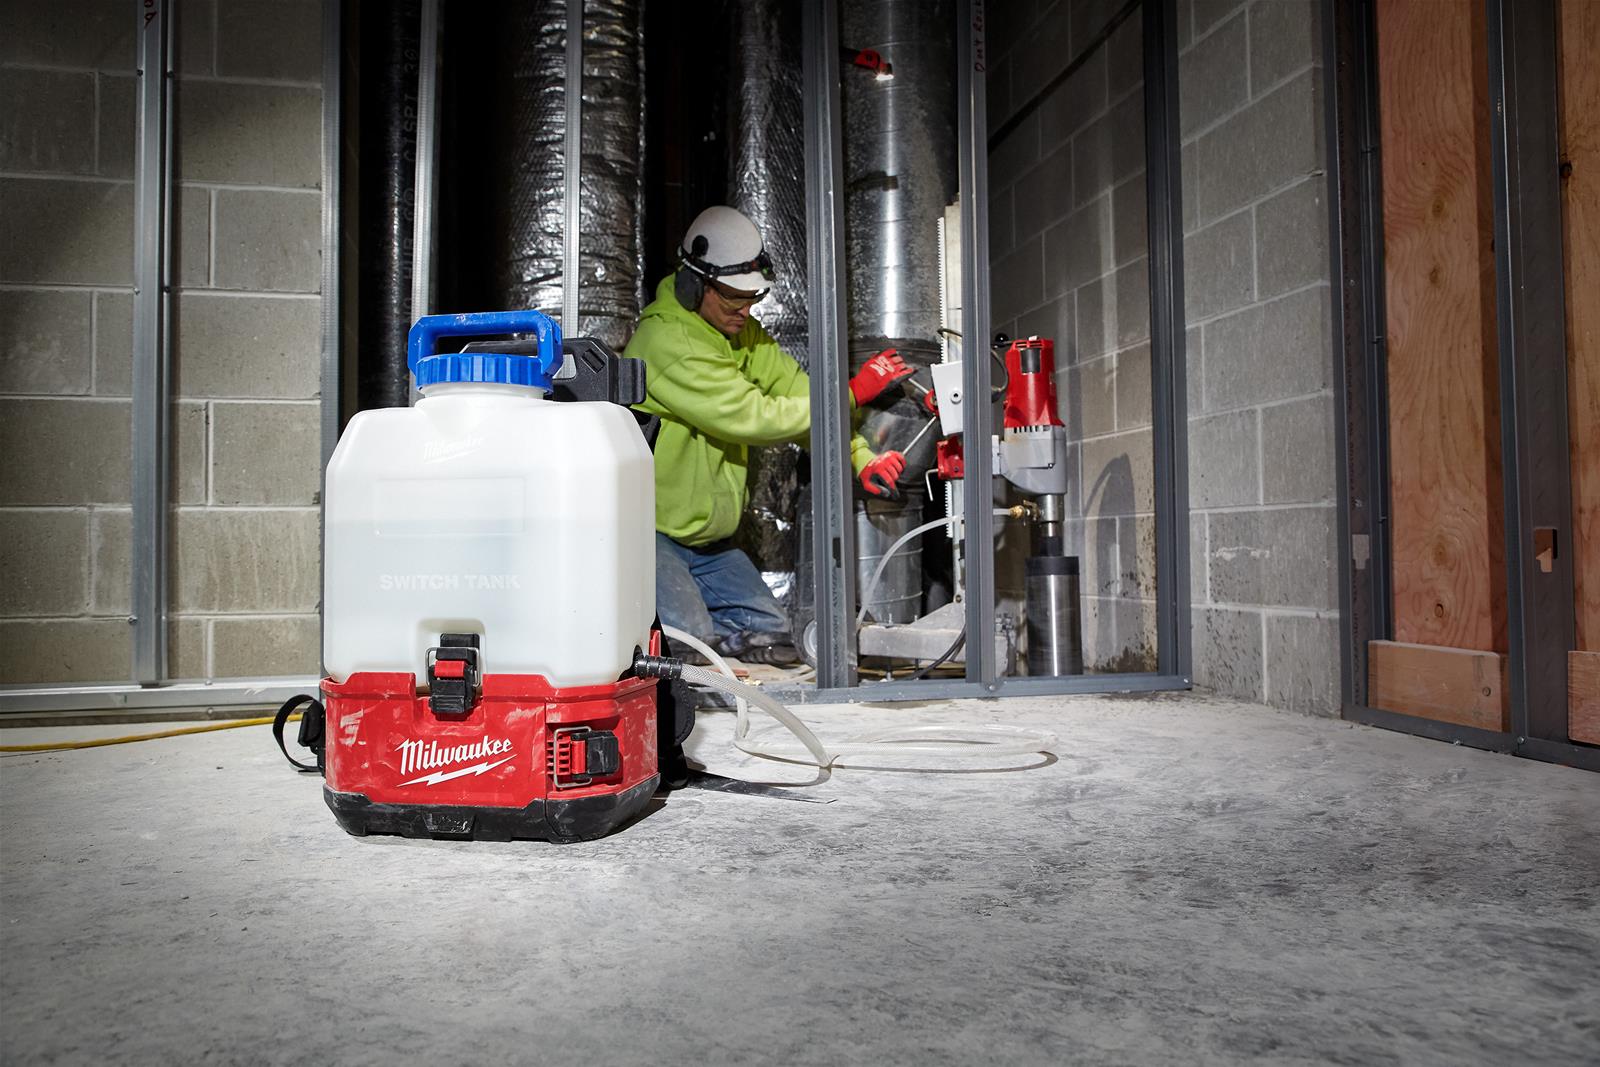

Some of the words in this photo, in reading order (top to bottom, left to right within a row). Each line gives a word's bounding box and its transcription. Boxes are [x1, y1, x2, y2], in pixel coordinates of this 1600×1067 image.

[379, 574, 459, 590] SWITCH
[464, 574, 521, 590] TANK
[394, 735, 514, 775] Milwaukee
